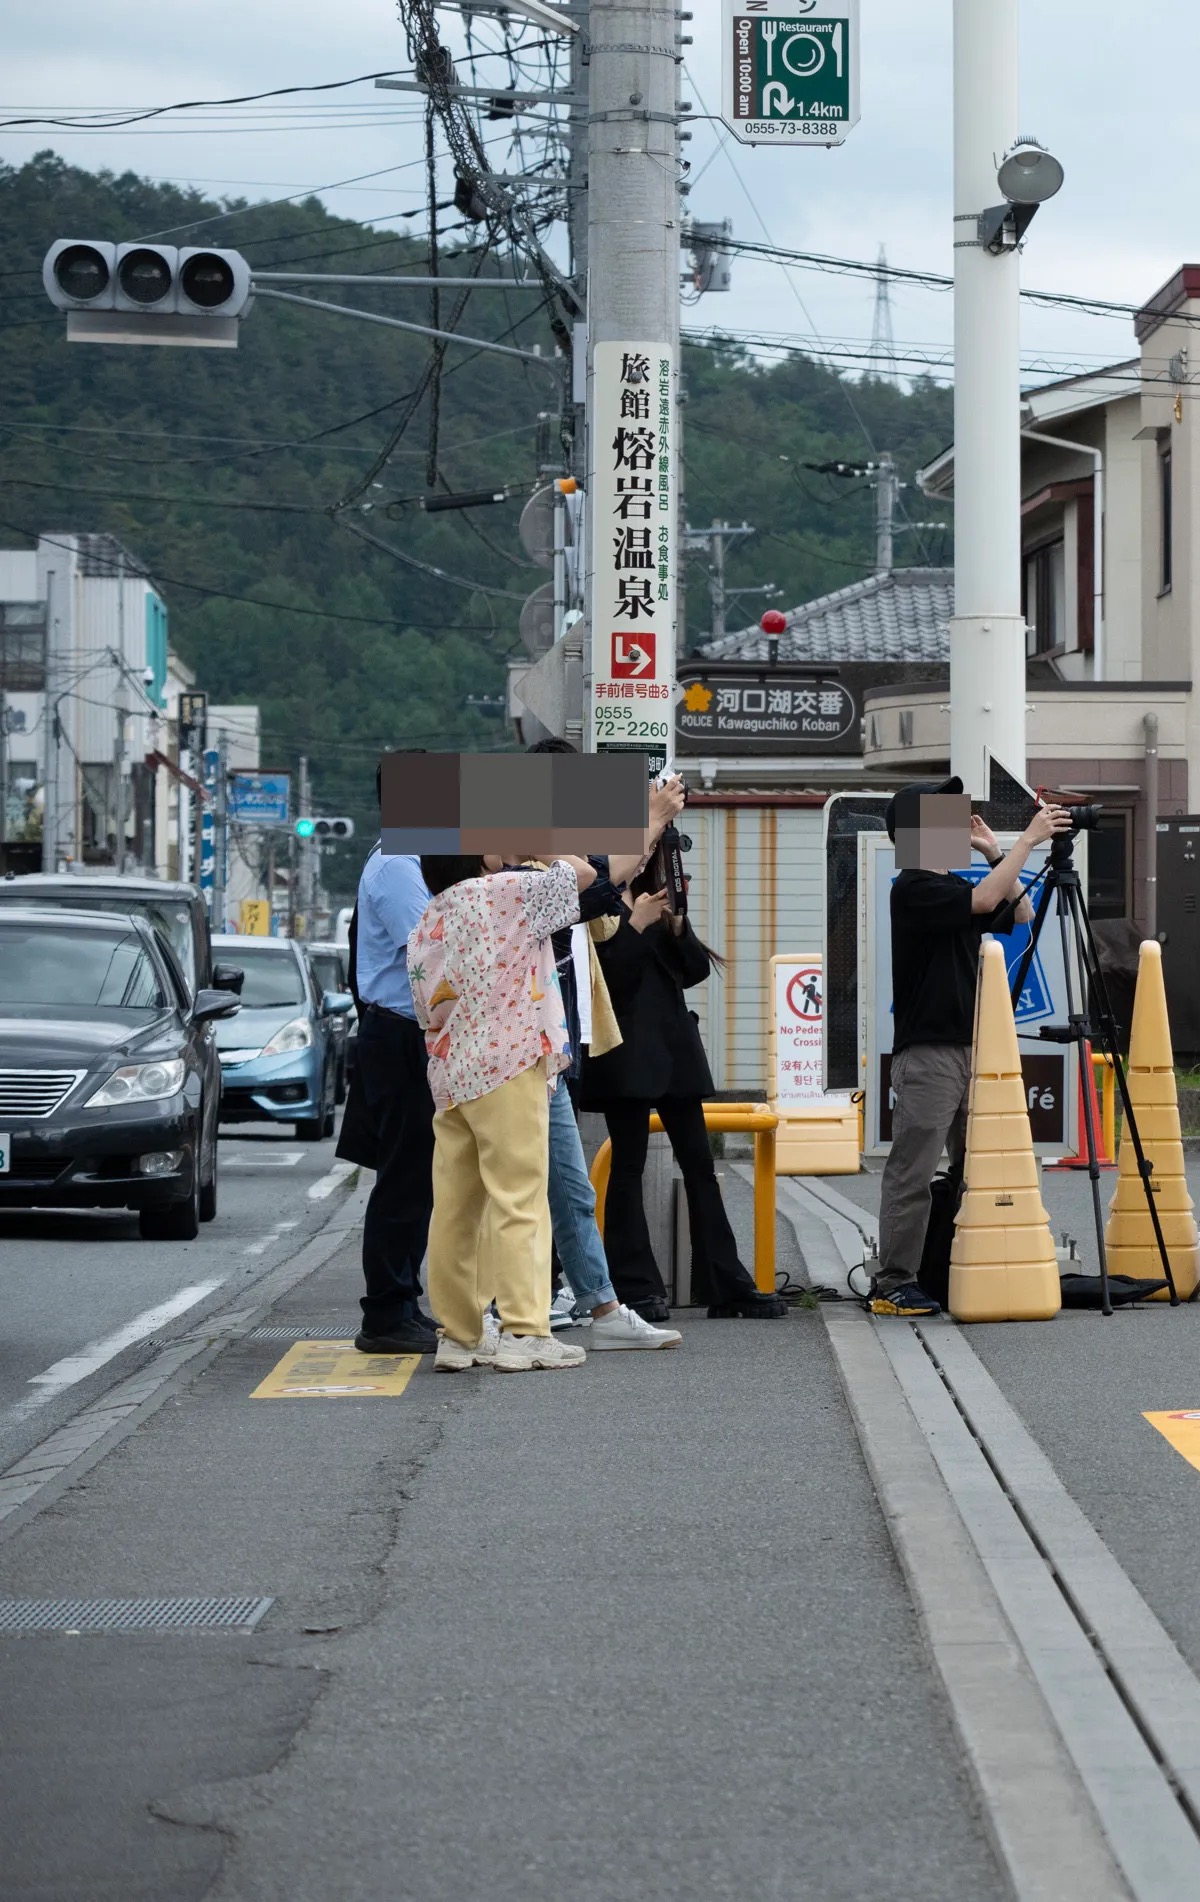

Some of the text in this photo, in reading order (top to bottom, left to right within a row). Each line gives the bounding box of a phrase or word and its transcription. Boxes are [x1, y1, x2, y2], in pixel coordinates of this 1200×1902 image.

[779, 21, 833, 33] Restaurant
[736, 19, 752, 116] Open 10:00 am
[796, 101, 843, 118] 1.4km
[745, 122, 838, 136] 0555-73-8388
[657, 525, 669, 601] お食事処
[595, 683, 669, 699] 手前信号曲る
[716, 688, 843, 715] 河口湖交番
[595, 706, 633, 719] 0555
[595, 721, 669, 737] 72-2260
[681, 715, 713, 727] POLICE
[718, 716, 840, 732] Kawaguchiko Koban
[671, 849, 683, 893] EOS DIGITAL
[780, 1026, 794, 1035] No
